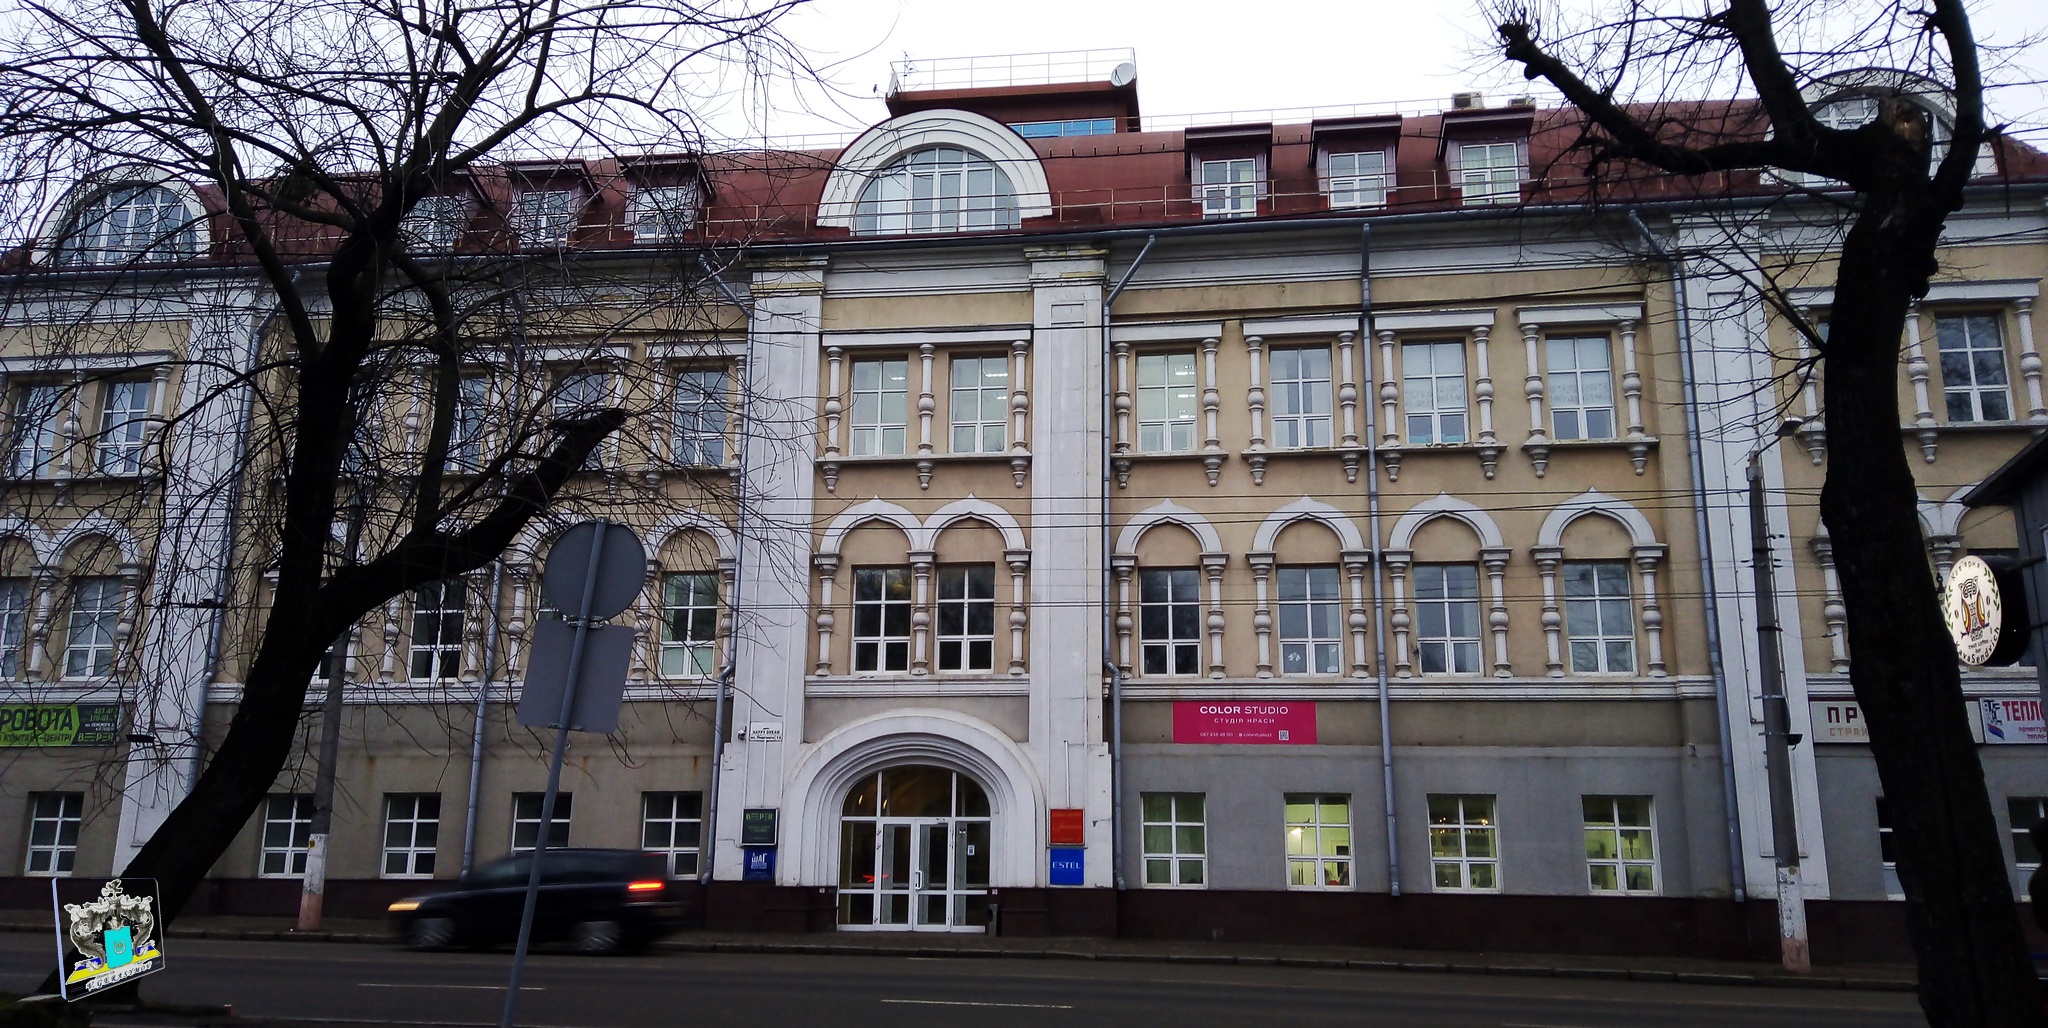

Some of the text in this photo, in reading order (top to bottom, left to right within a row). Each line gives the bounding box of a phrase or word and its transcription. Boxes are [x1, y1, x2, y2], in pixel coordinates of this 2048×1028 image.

[1199, 706, 1289, 714] COLOR STUDIO
[1827, 707, 1858, 723] ПР
[1052, 861, 1081, 869] ESTEL
